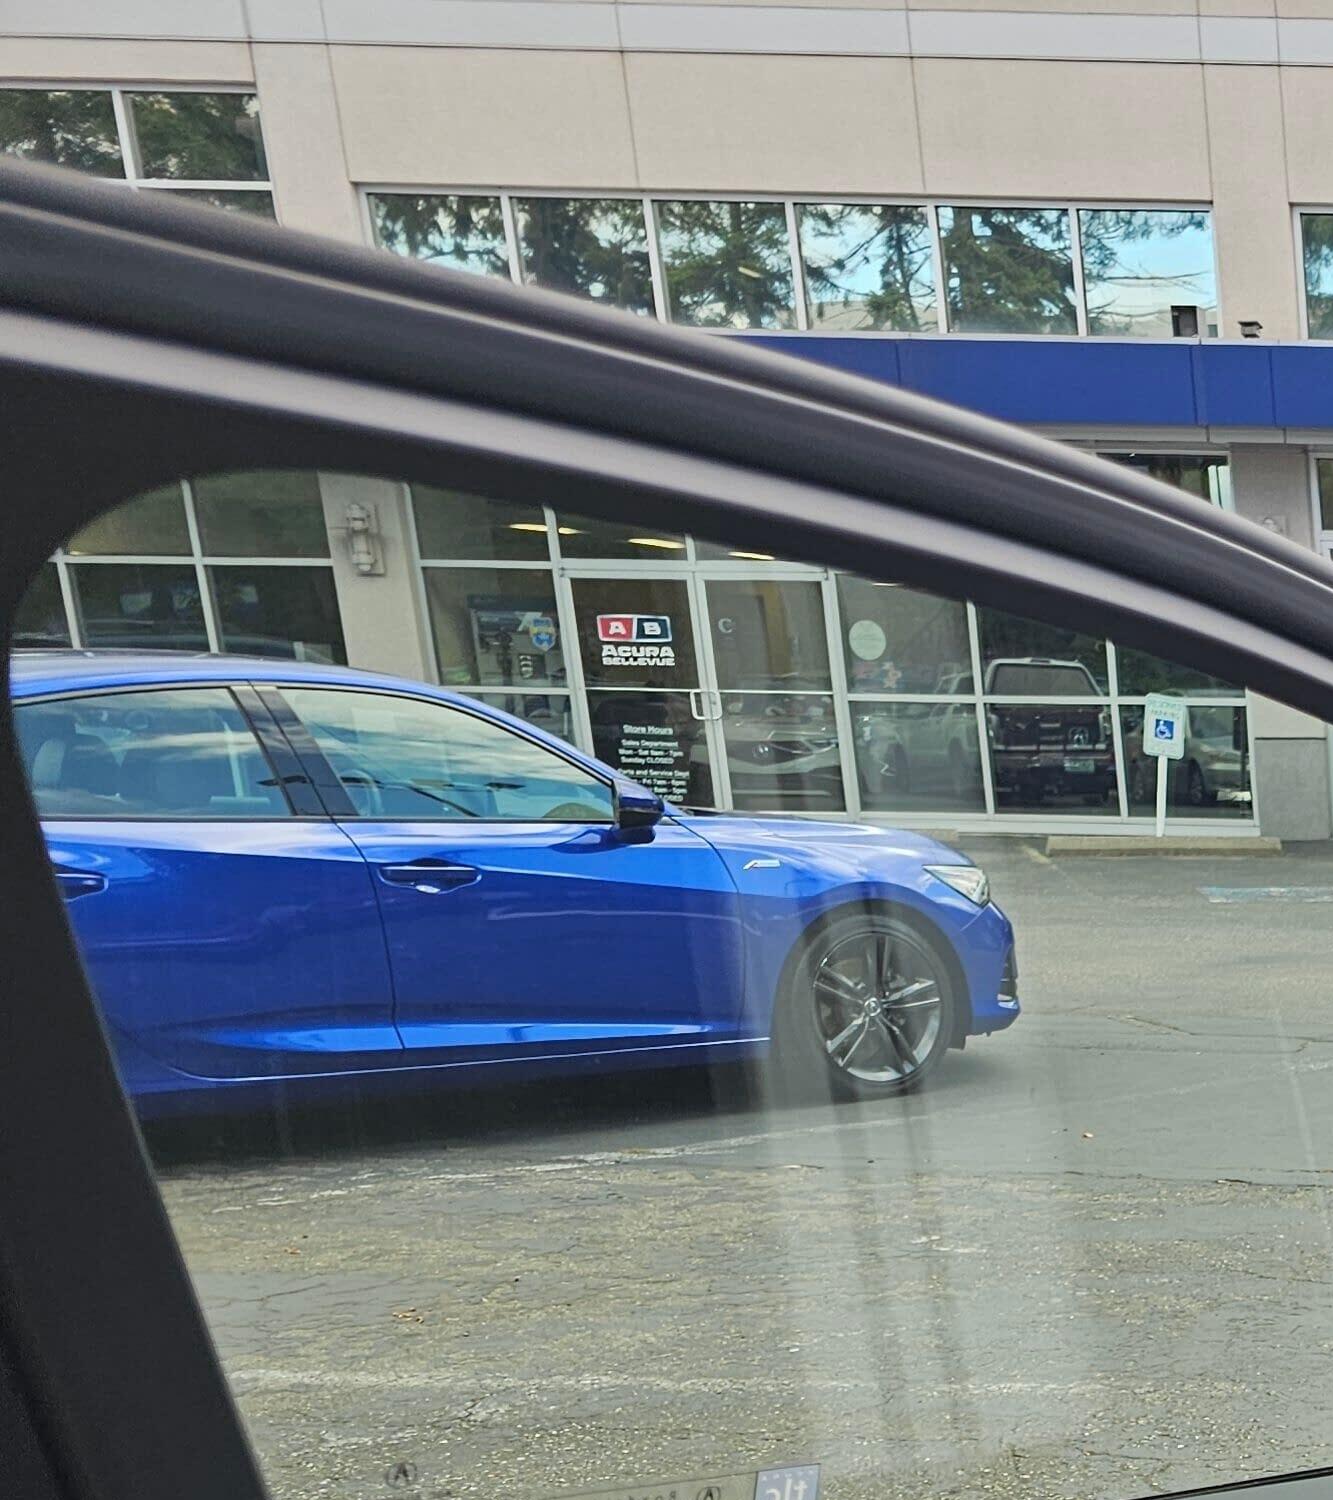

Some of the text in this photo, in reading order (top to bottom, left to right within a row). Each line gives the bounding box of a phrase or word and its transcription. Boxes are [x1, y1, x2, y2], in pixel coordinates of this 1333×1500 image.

[602, 644, 675, 657] ACURA
[602, 657, 675, 666] BELLEVUE
[623, 724, 673, 735] Store Hours
[620, 756, 674, 765] Sunday CLOSED
